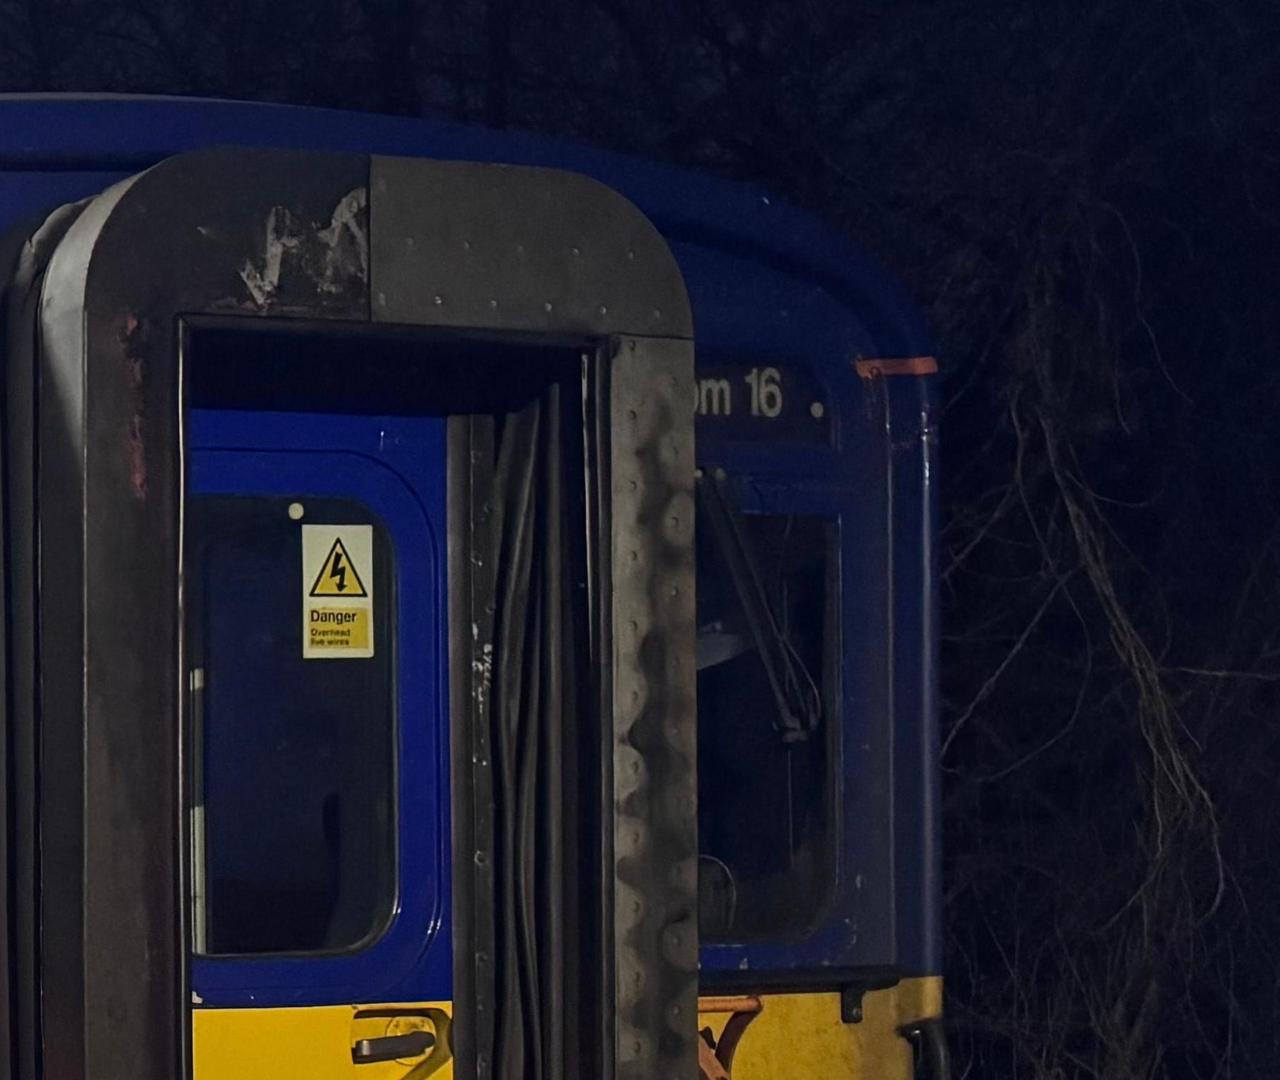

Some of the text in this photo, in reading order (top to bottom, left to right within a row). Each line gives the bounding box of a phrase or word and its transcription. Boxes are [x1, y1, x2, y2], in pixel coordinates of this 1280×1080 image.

[694, 367, 782, 418] m 16
[310, 610, 357, 625] Danger
[310, 628, 351, 637] Overhead
